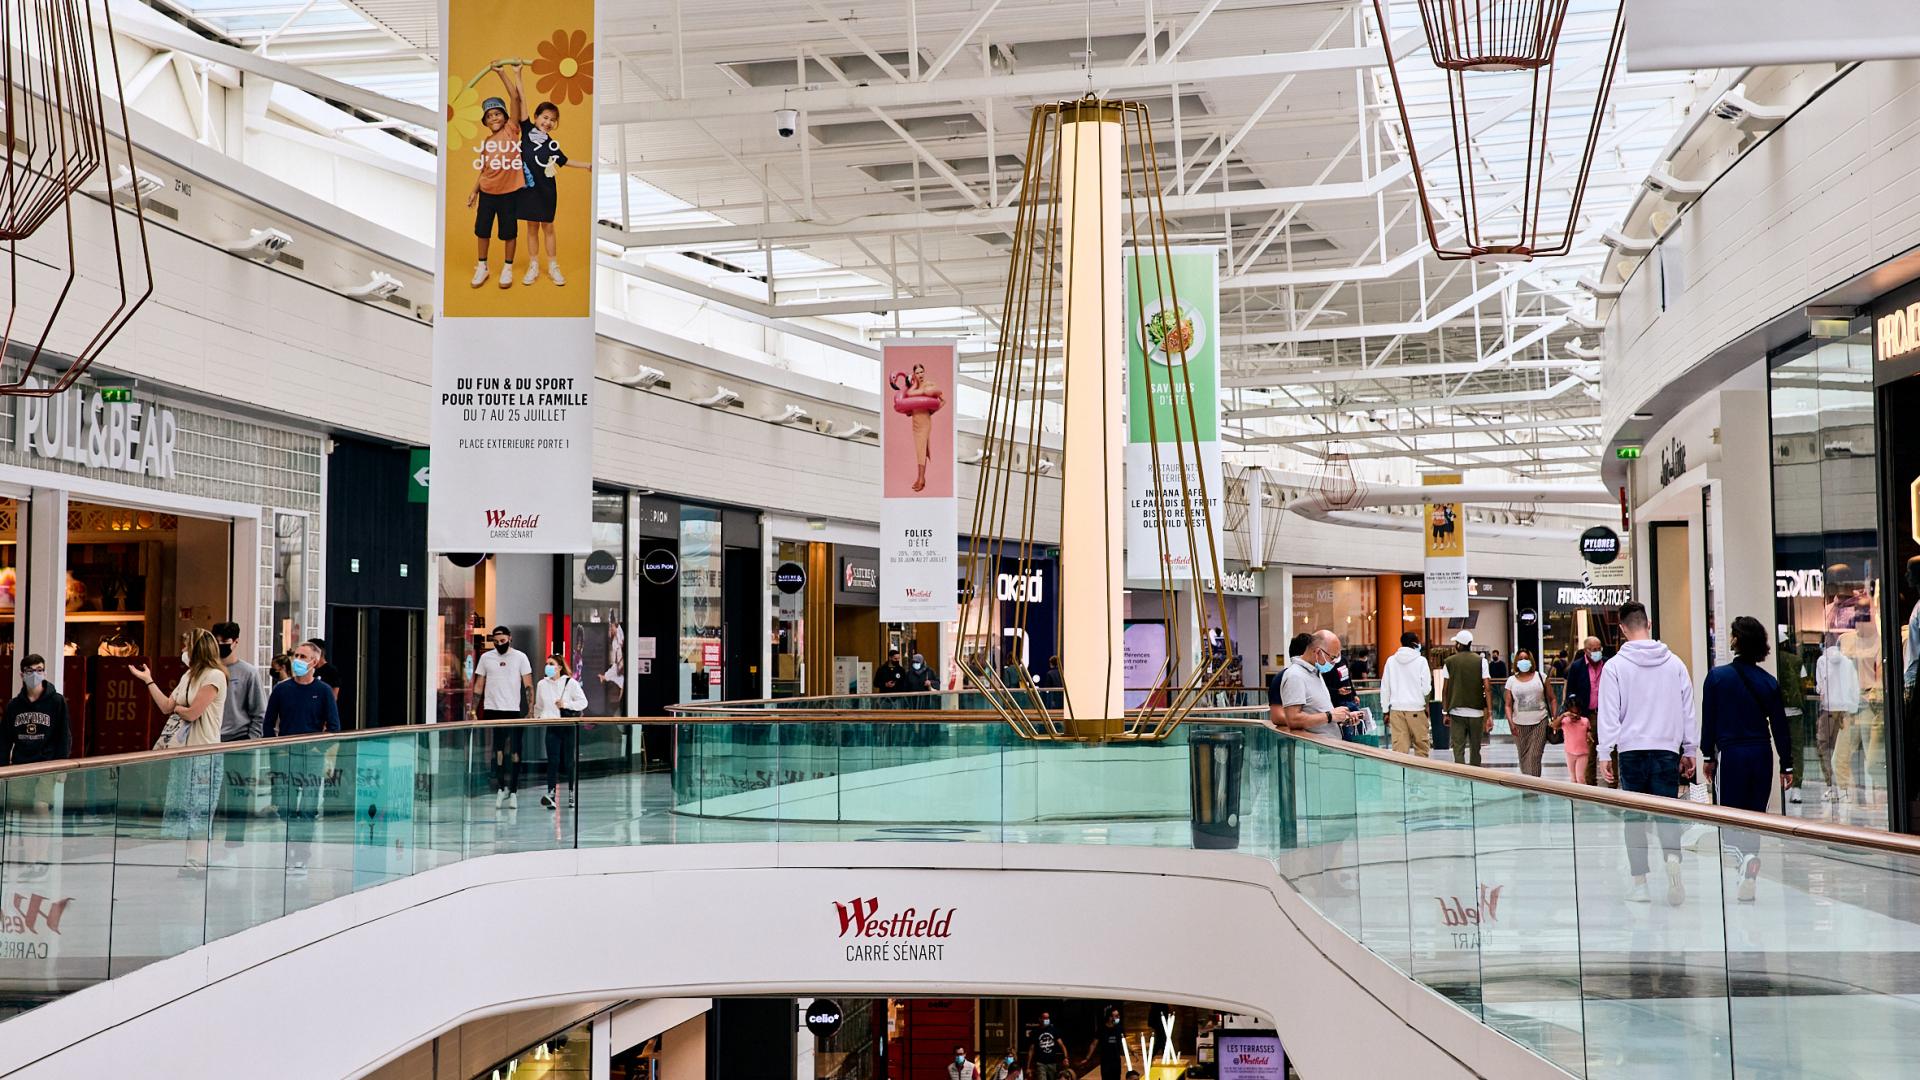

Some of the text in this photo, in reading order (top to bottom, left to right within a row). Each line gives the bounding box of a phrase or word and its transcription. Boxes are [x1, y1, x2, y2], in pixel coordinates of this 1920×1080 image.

[472, 156, 524, 170] d'été
[457, 378, 575, 390] DU FUN & DU SPORT
[441, 393, 588, 406] POUR TOUTE LA FAMILLE
[463, 409, 567, 422] DU 7 AU 25 JUILLET
[459, 439, 484, 449] PLACE
[487, 439, 535, 449] EXTERIEURE
[537, 439, 564, 449] PORTE
[1131, 500, 1141, 508] LE
[484, 509, 540, 529] Westfield
[490, 529, 533, 539] CARRÉ SÉNART
[904, 529, 933, 538] FOLIES
[1583, 538, 1616, 549] PYLONES
[107, 680, 137, 699] SOL
[106, 701, 137, 721] DES
[832, 896, 958, 939] Westfield
[846, 941, 945, 961] CARRÉ SÉNART
[1227, 1044, 1275, 1053] LES TERRASSES
